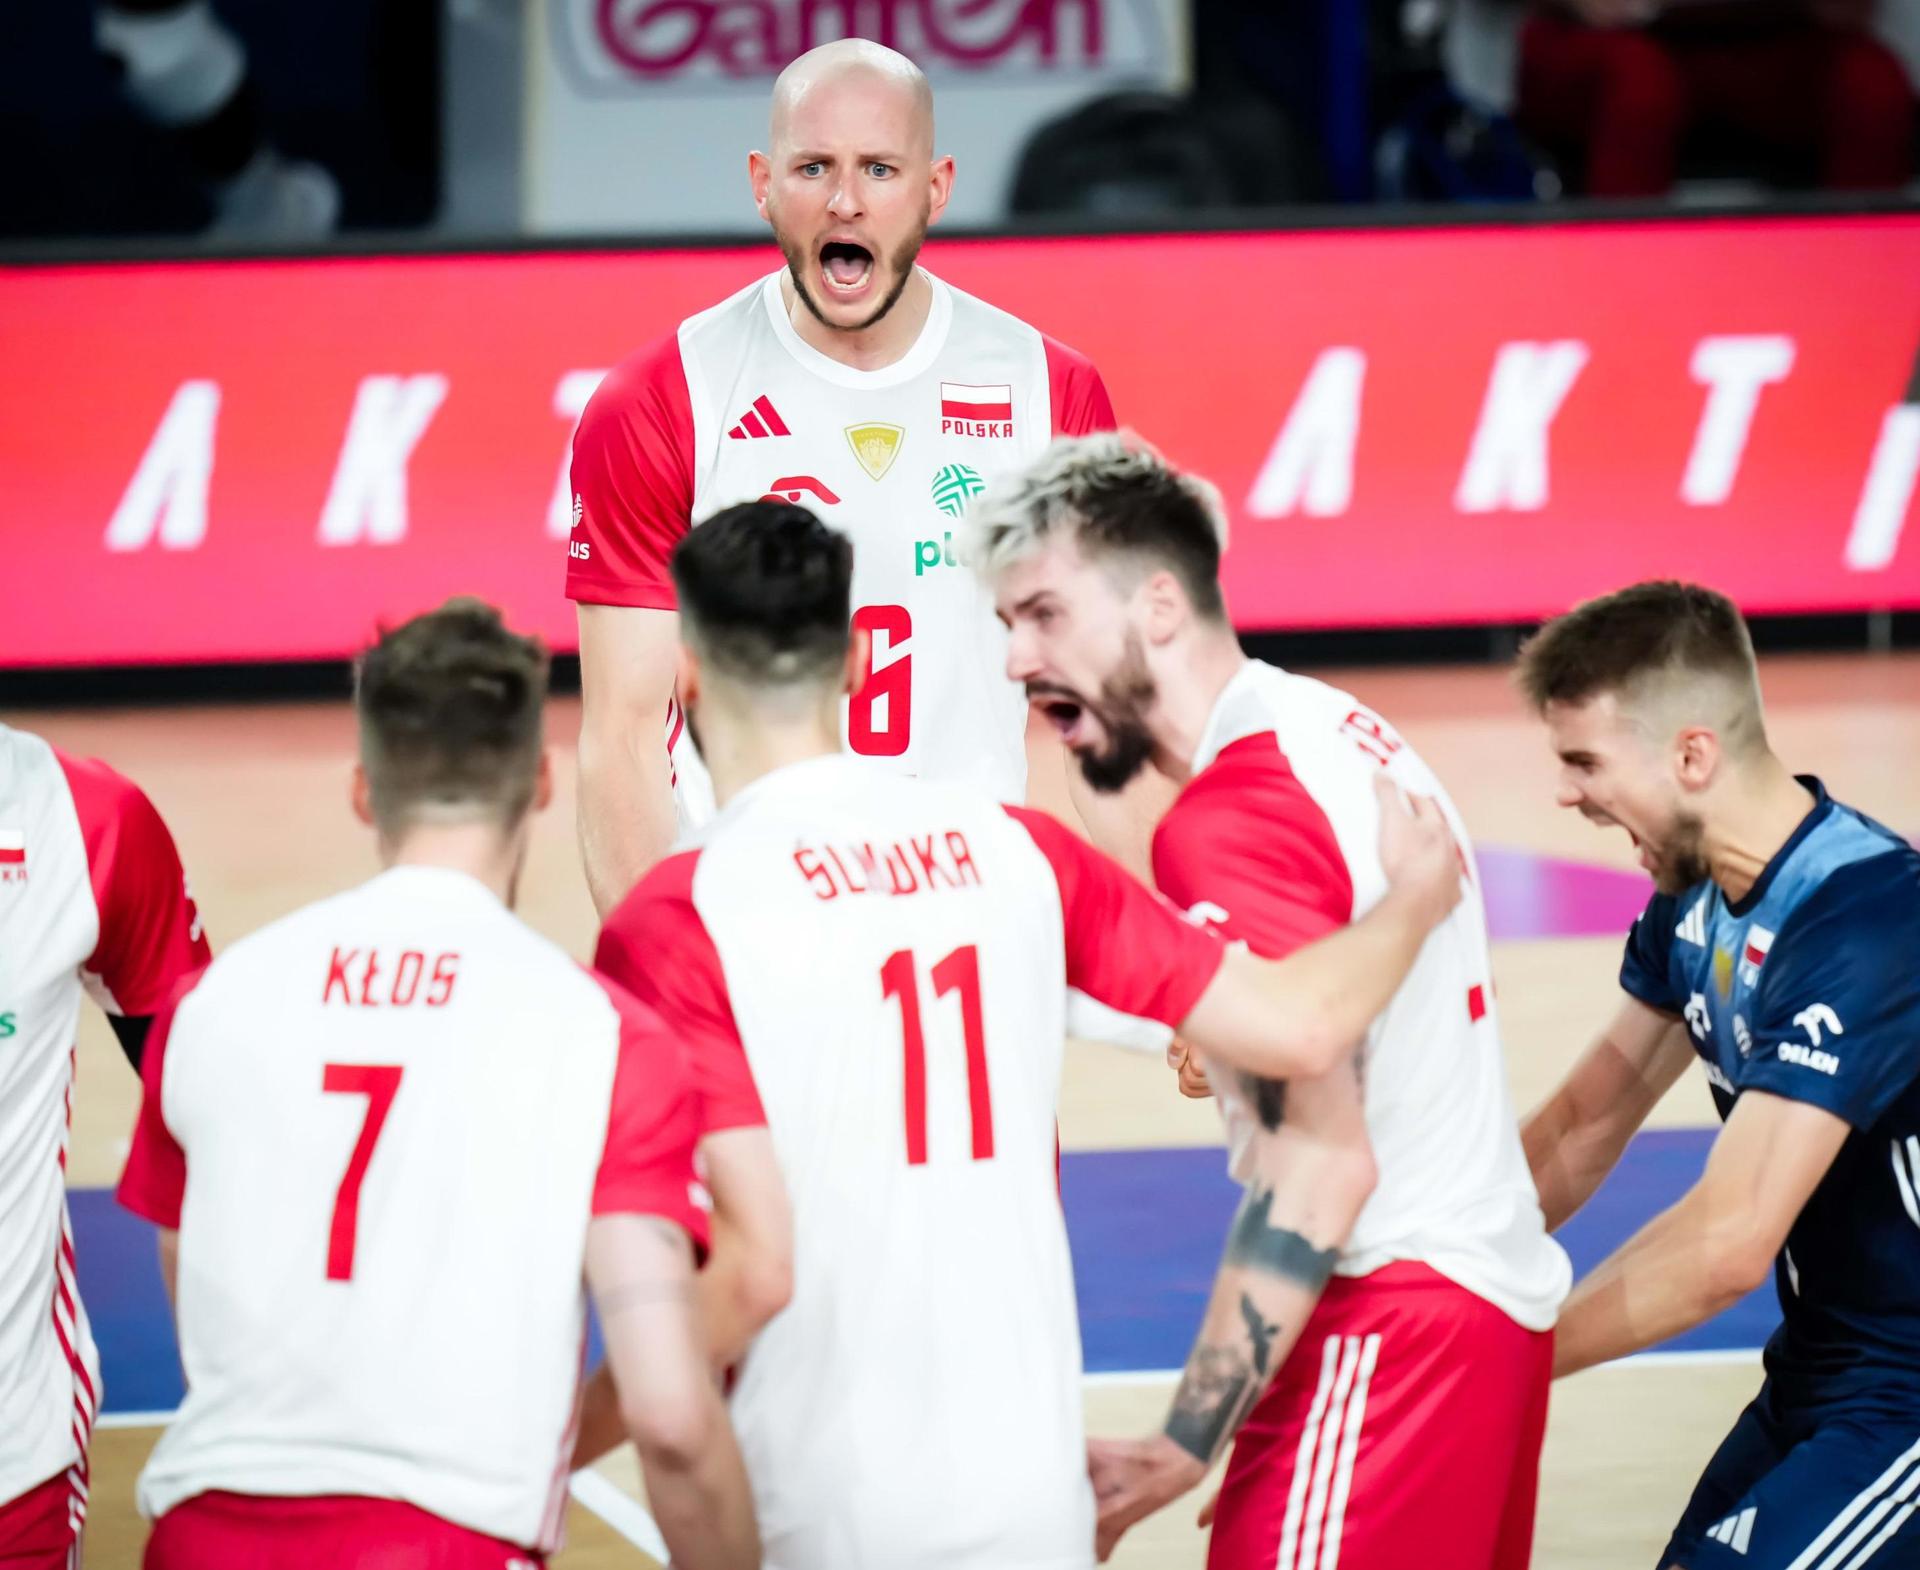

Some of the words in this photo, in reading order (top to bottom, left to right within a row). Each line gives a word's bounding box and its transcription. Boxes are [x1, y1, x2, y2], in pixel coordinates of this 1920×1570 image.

[942, 420, 1013, 438] POLSKA
[567, 540, 590, 560] us
[848, 604, 912, 756] 6
[322, 947, 461, 1007] KŁOS
[880, 944, 994, 1165] 11
[322, 1063, 404, 1282] 7
